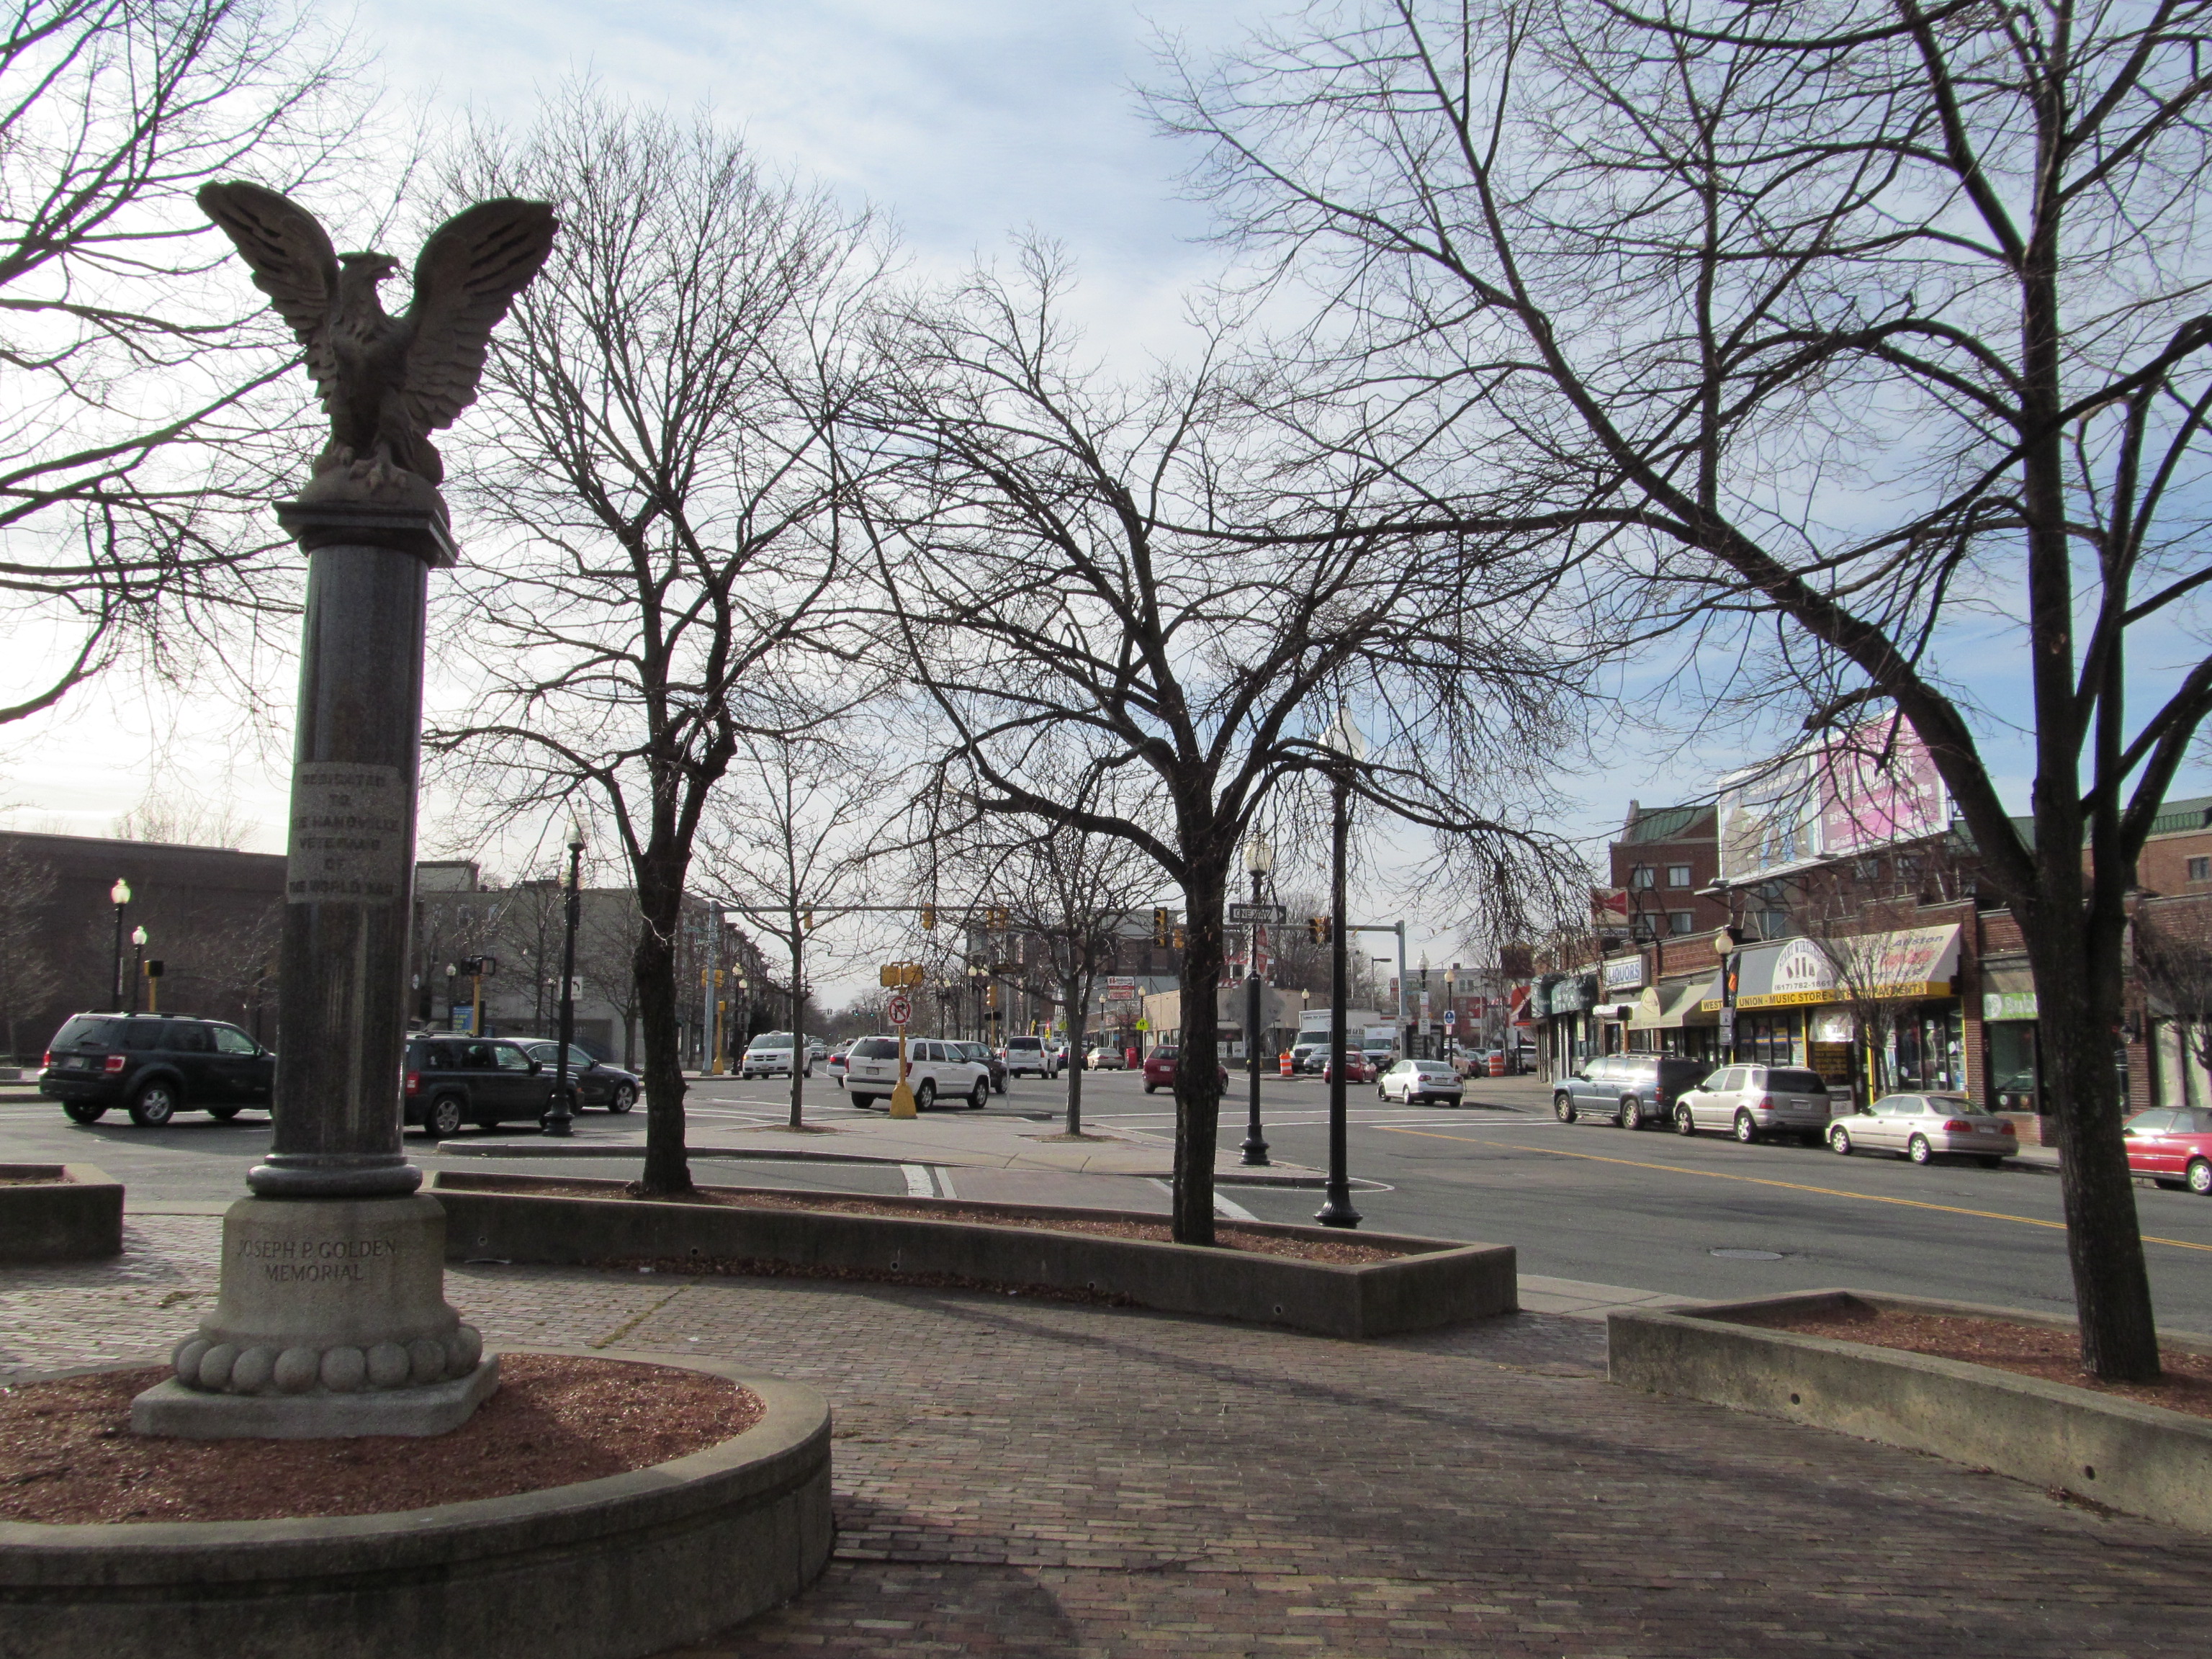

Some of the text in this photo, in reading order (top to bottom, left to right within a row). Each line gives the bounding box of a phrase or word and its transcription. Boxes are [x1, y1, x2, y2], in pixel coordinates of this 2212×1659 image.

[302, 773, 385, 786] DEDICATED
[329, 794, 351, 806] TO
[299, 837, 381, 850] VETERANS
[324, 858, 346, 871] OF
[309, 880, 361, 894] WORLD
[1607, 964, 1640, 983] LIQUORS
[1739, 997, 1763, 1007] UNION
[1769, 994, 1796, 1004] MUSIC
[1798, 992, 1827, 1002] STORE
[238, 1239, 294, 1258] JOSEPH
[319, 1239, 397, 1258] GOLDEN
[266, 1264, 363, 1282] MEMORIAL
